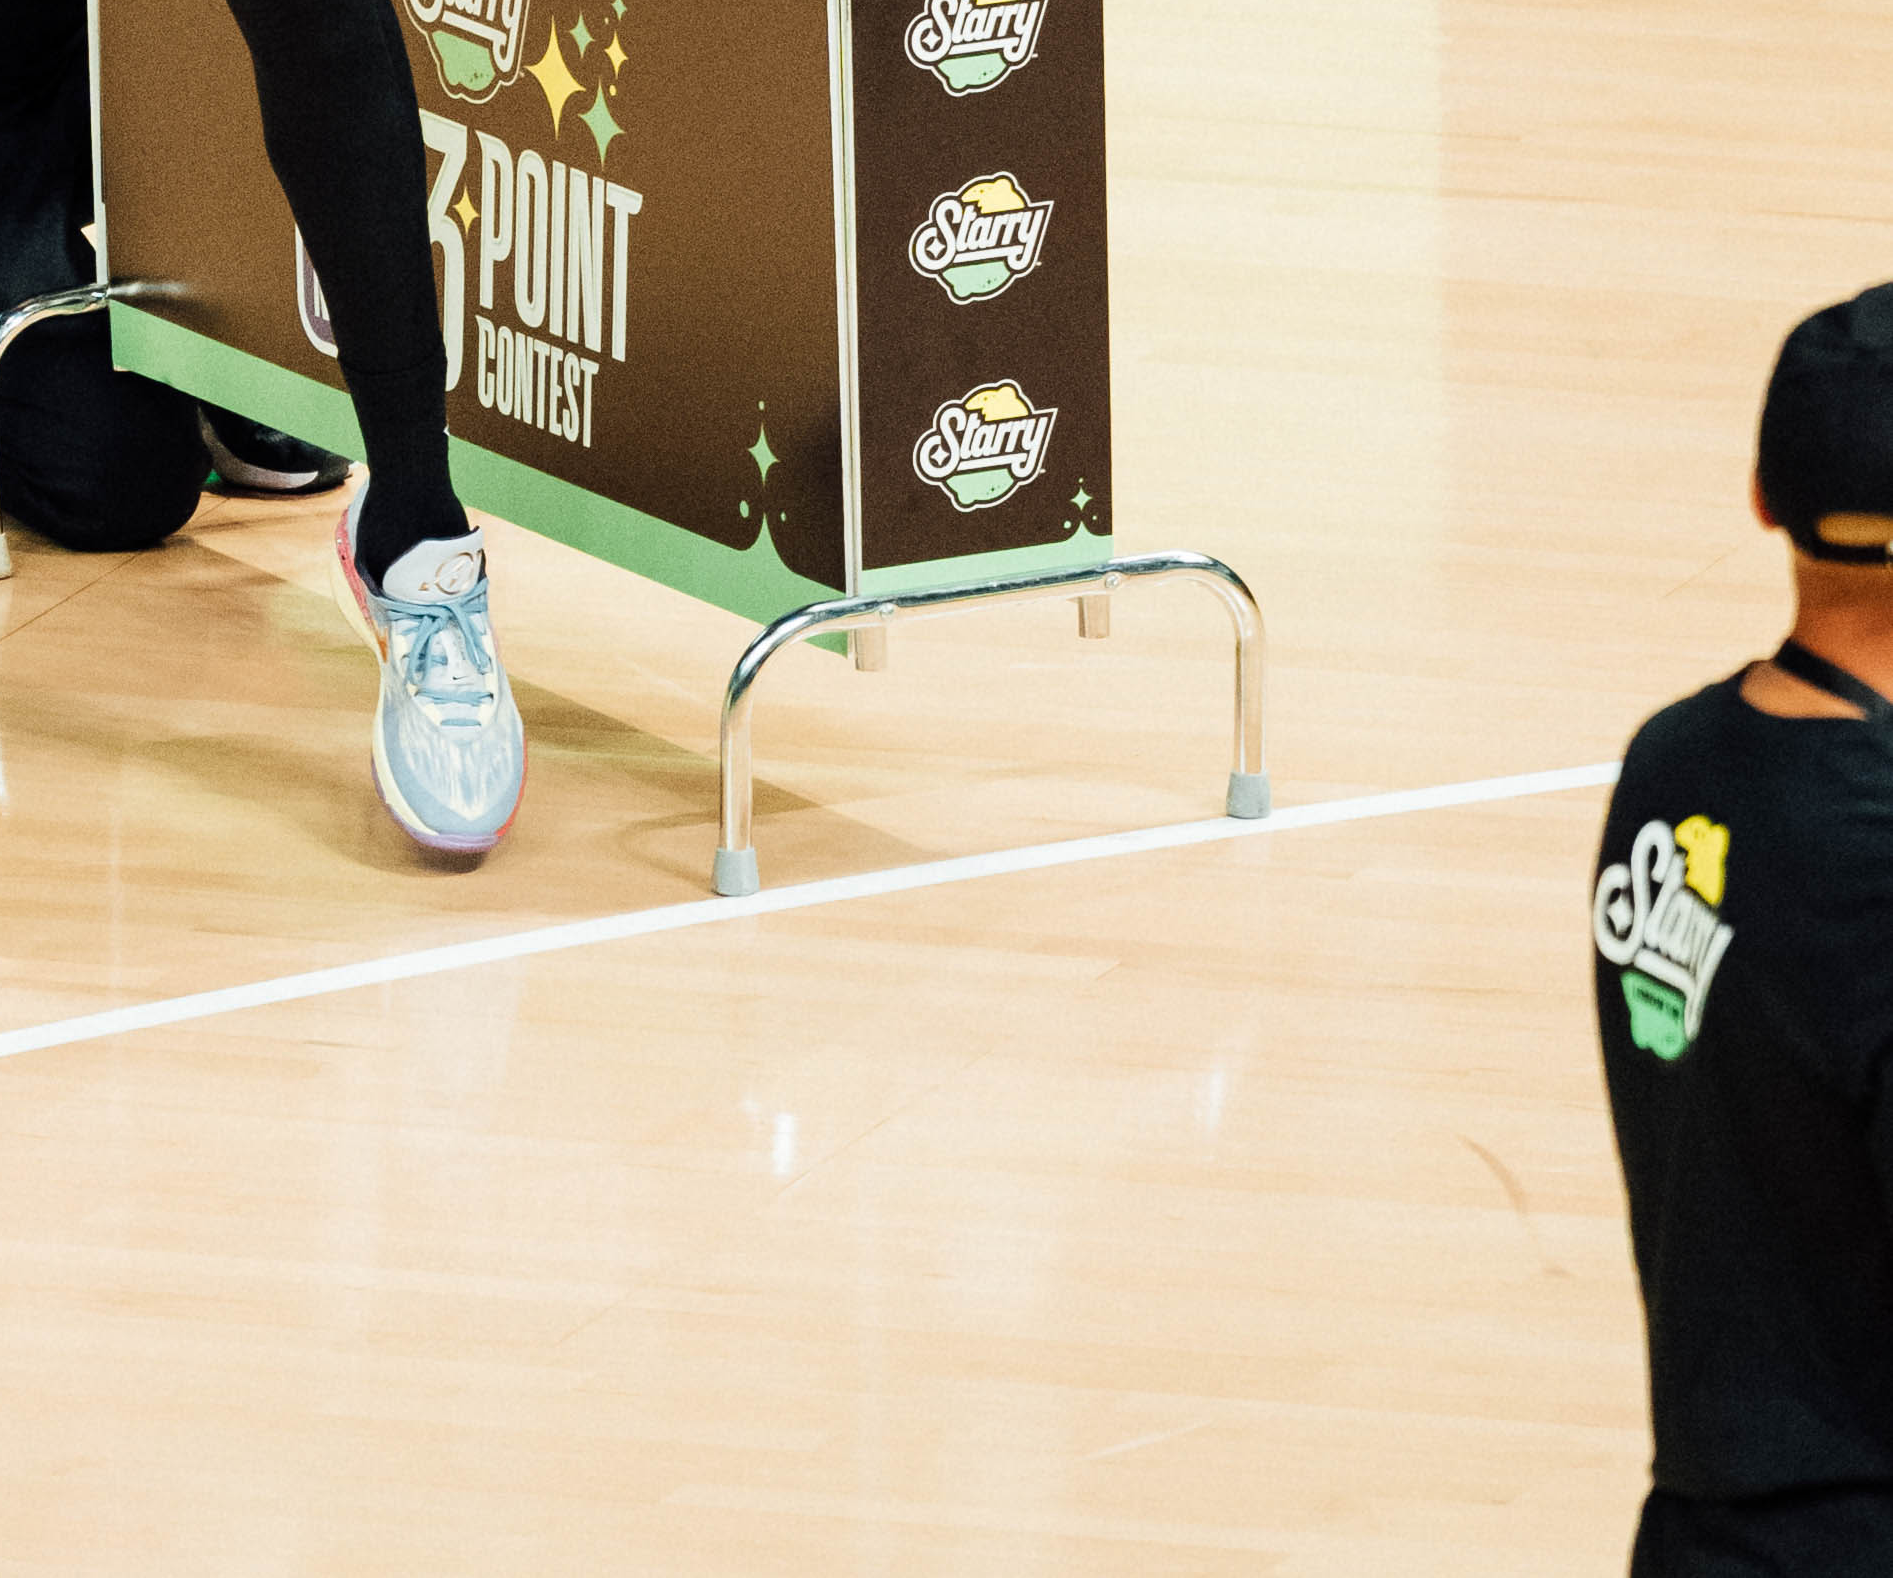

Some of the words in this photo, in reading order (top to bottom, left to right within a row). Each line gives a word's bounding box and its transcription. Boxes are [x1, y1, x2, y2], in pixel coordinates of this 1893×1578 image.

[474, 129, 644, 363] POINT
[915, 199, 1045, 271] Starry
[474, 314, 600, 449] CONTEST
[919, 406, 1049, 478] Starry
[1593, 819, 1735, 1043] Starry
